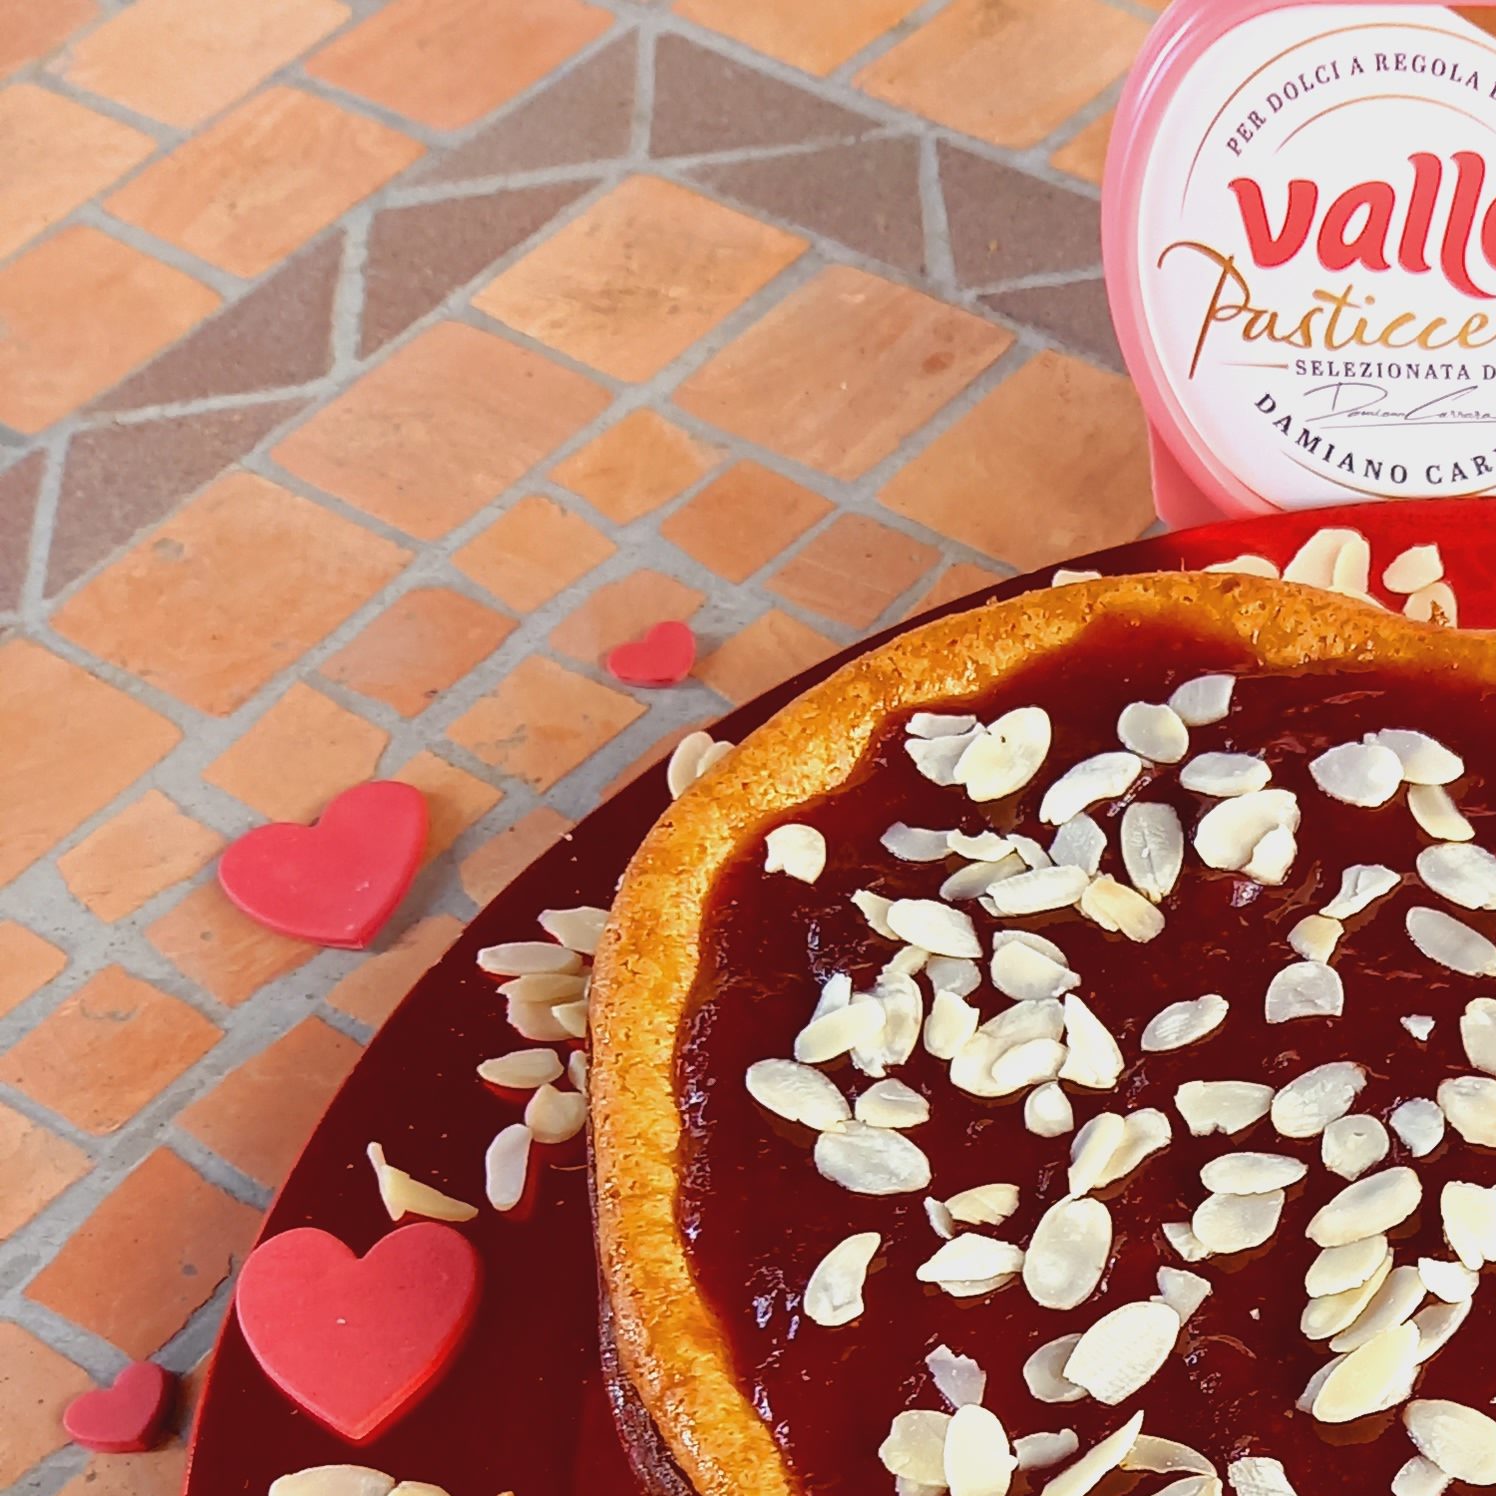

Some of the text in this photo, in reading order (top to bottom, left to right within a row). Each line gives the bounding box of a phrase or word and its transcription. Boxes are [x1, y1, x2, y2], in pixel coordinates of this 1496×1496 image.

[1226, 110, 1267, 157] PER
[1266, 61, 1340, 115] DOLCI
[1350, 56, 1364, 76] A
[1375, 52, 1479, 90] REGOLA
[1295, 360, 1471, 380] SELEZIONATA
[1254, 391, 1408, 484] DAMIANO
